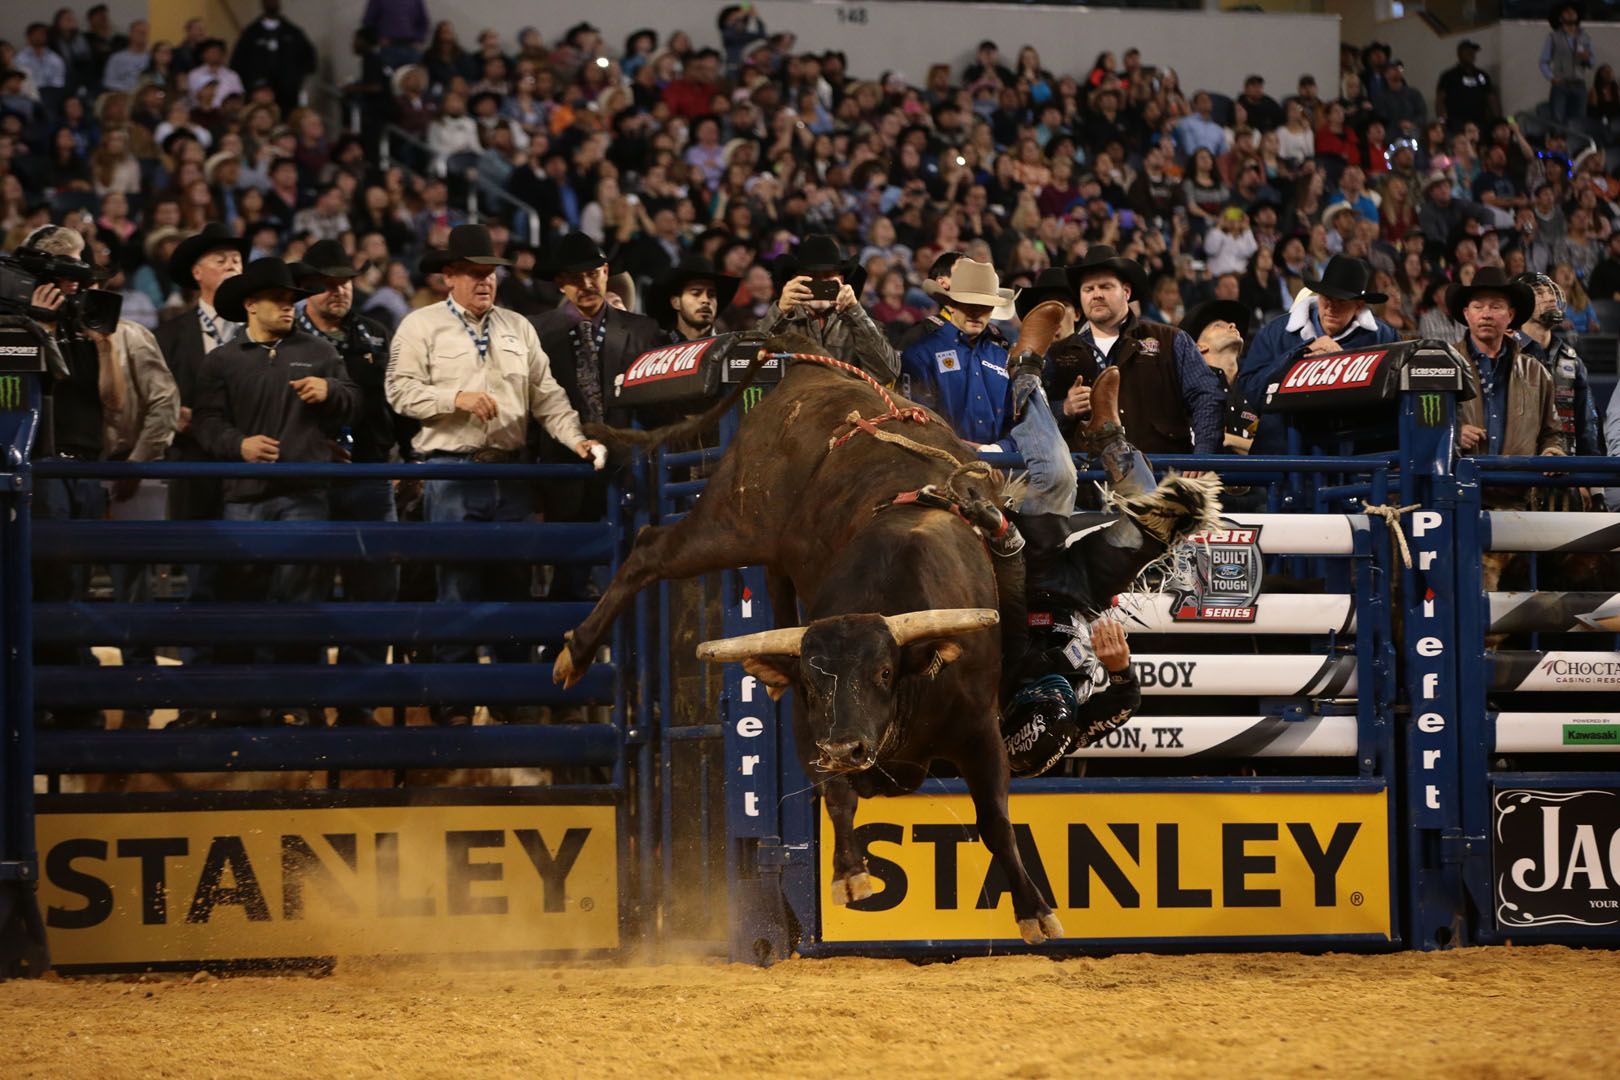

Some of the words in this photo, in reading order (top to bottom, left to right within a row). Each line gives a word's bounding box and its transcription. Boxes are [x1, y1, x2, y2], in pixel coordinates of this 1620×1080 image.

[837, 7, 869, 25] 148
[627, 346, 685, 381] LUCAS
[673, 342, 708, 372] OIL
[1284, 356, 1352, 389] LUCAS
[1342, 354, 1380, 383] OIL
[1212, 551, 1248, 565] BUILT
[1212, 580, 1248, 591] TOUGH
[1204, 608, 1251, 618] SERIES
[1152, 727, 1183, 748] TX
[1567, 730, 1617, 740] Kawasaki
[844, 821, 1363, 912] STANLEY
[45, 827, 592, 930] STANLEY
[1588, 900, 1619, 908] YOUR
